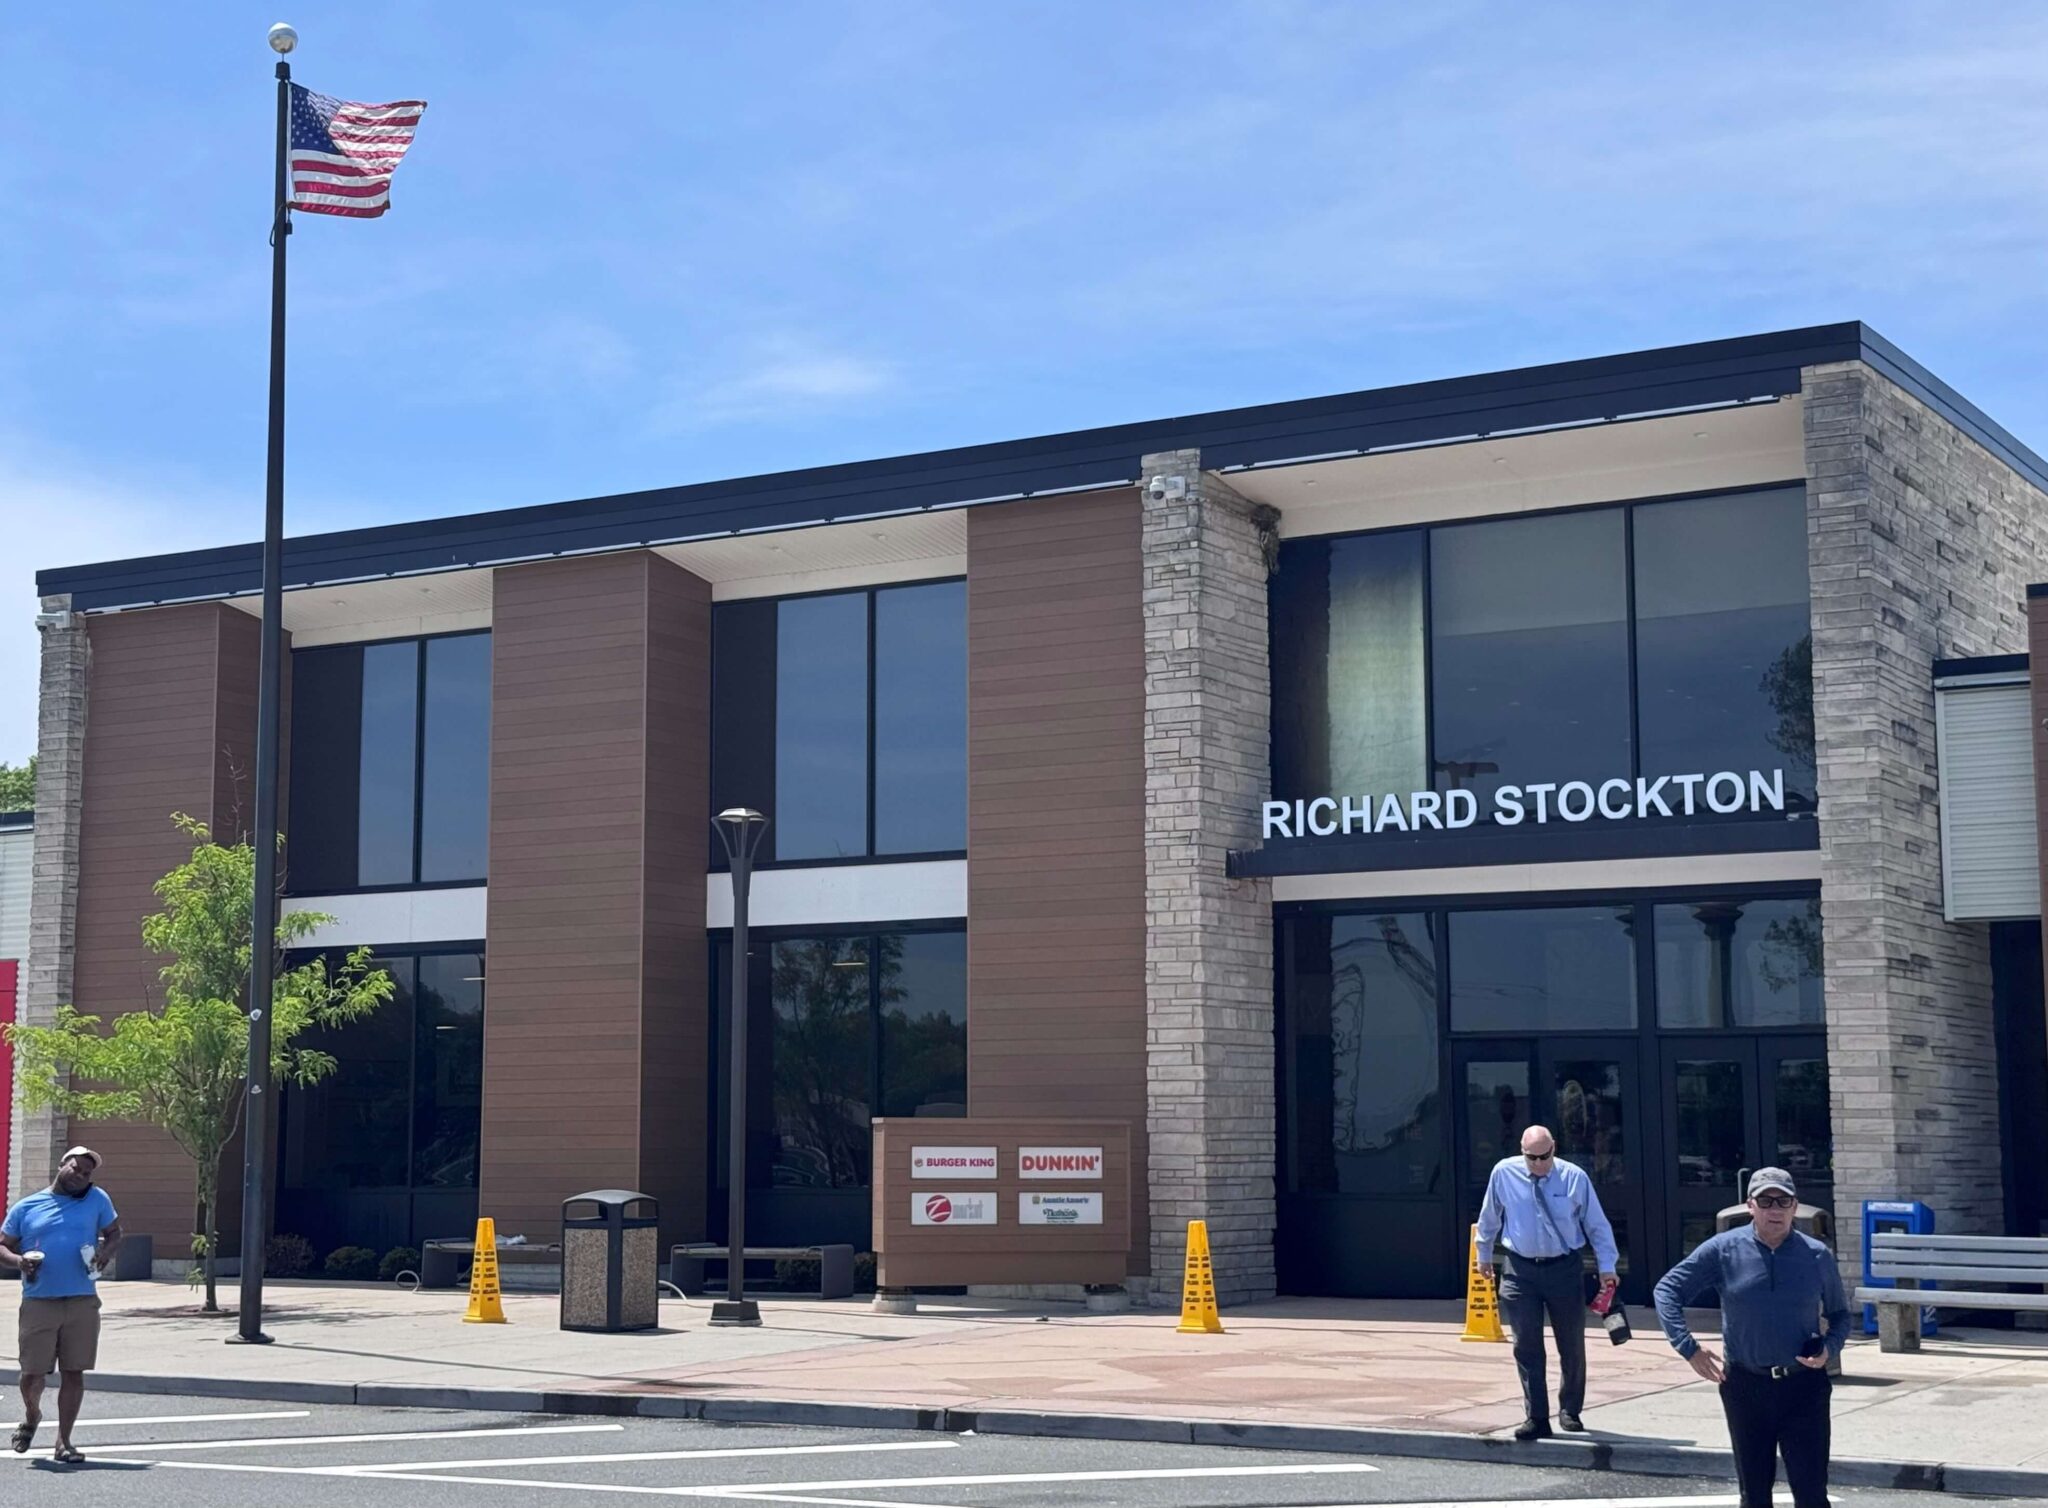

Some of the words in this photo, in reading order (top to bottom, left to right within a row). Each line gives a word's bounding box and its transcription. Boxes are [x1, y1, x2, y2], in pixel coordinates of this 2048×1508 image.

[1263, 789, 1478, 839] RICHARD
[1494, 769, 1784, 826] STOCKTON
[926, 1158, 967, 1167] BURGER
[969, 1158, 995, 1167] KING
[1022, 1155, 1100, 1171] DUNKIN'
